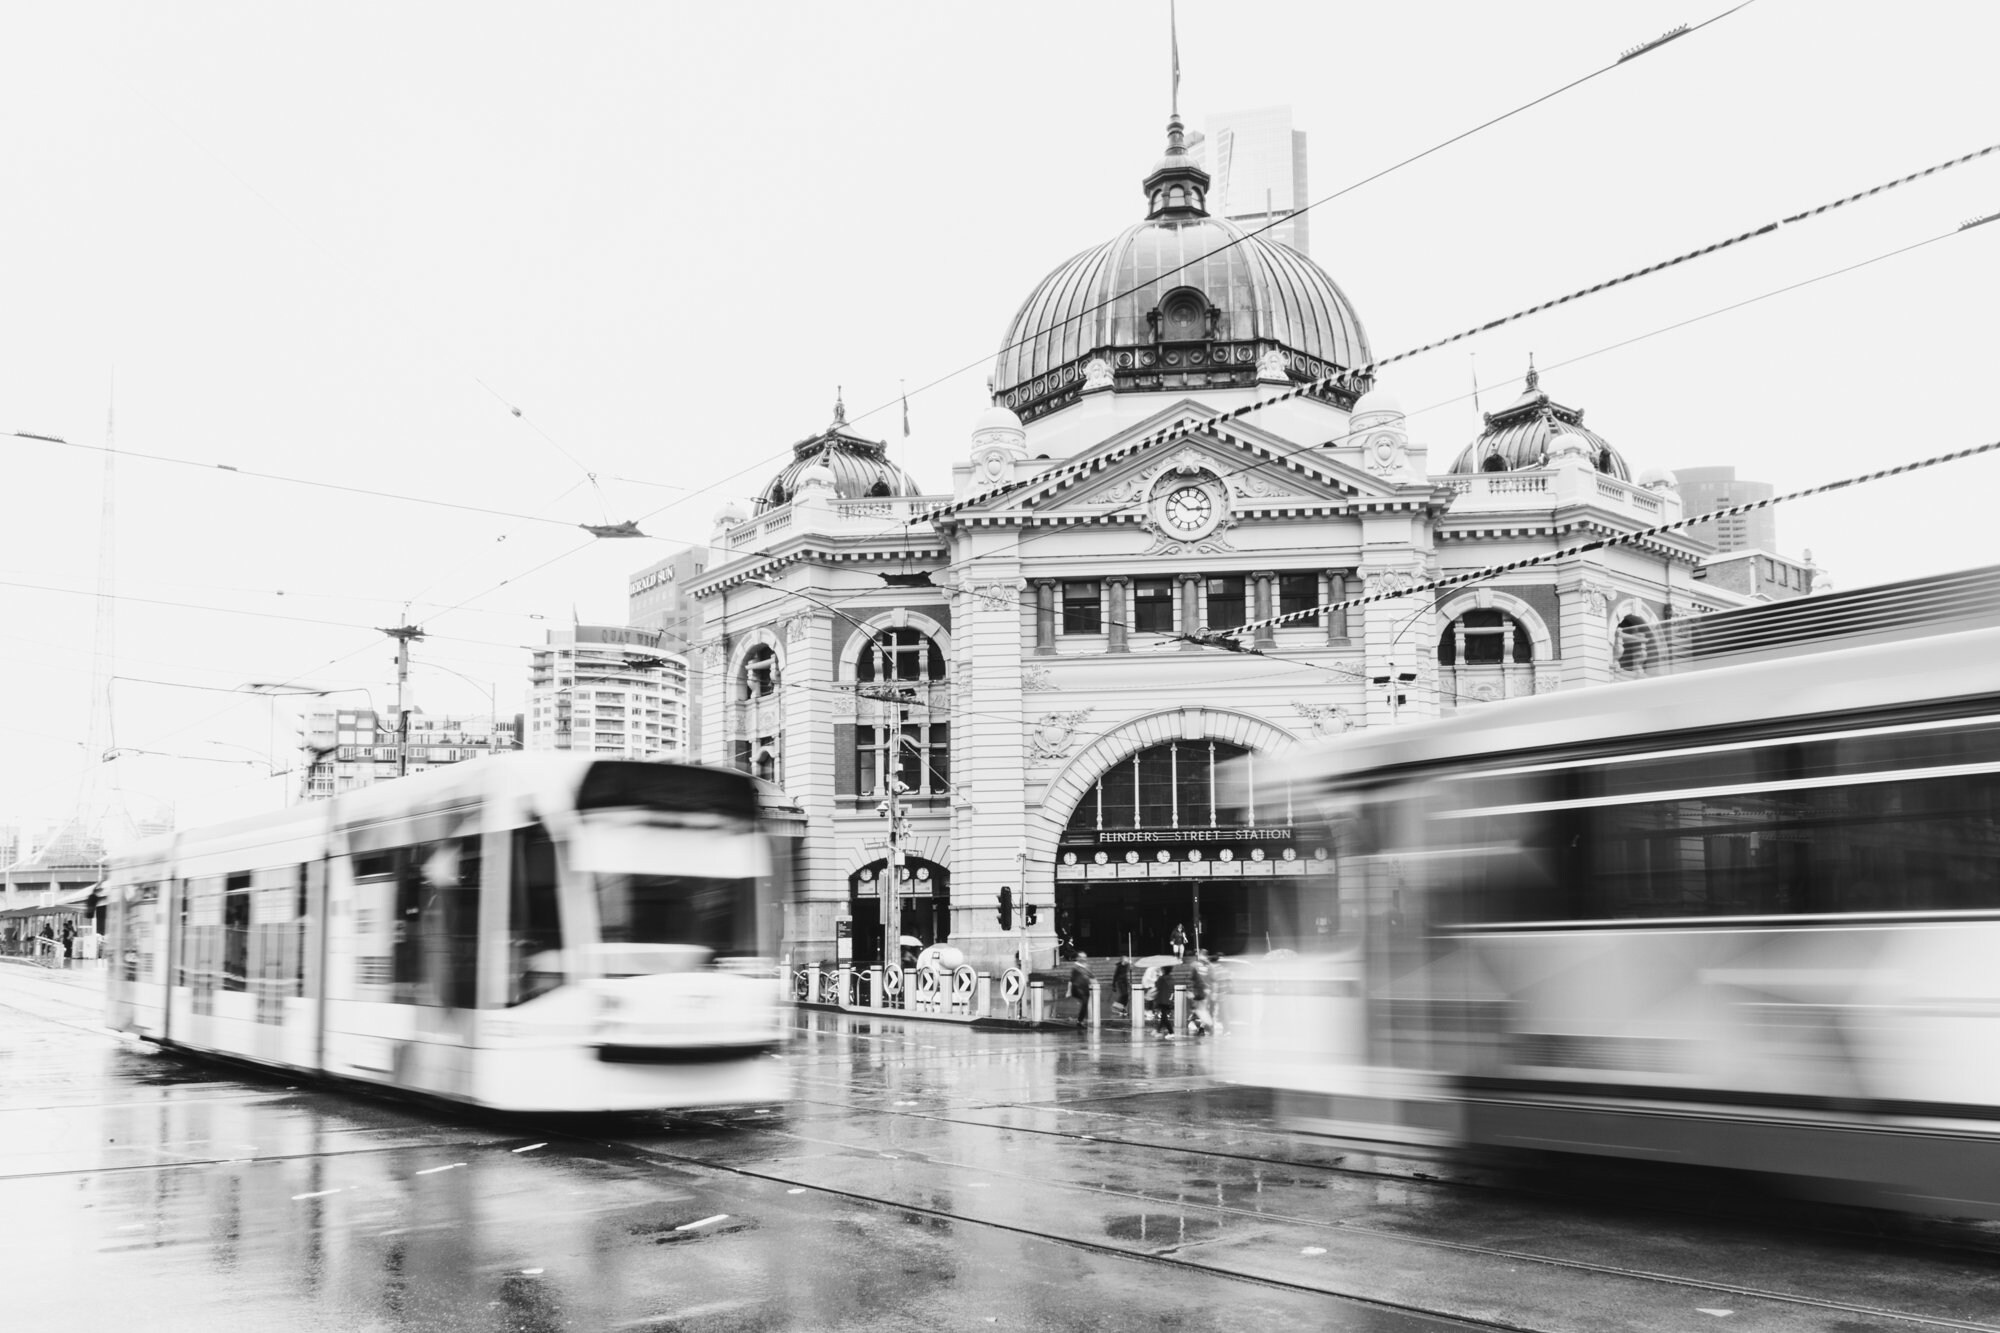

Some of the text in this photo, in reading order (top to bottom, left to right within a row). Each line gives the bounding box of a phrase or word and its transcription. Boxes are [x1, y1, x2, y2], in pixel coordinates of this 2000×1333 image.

[602, 630, 630, 643] QUAY
[1100, 829, 1291, 842] FLINDERS STREET STATION
